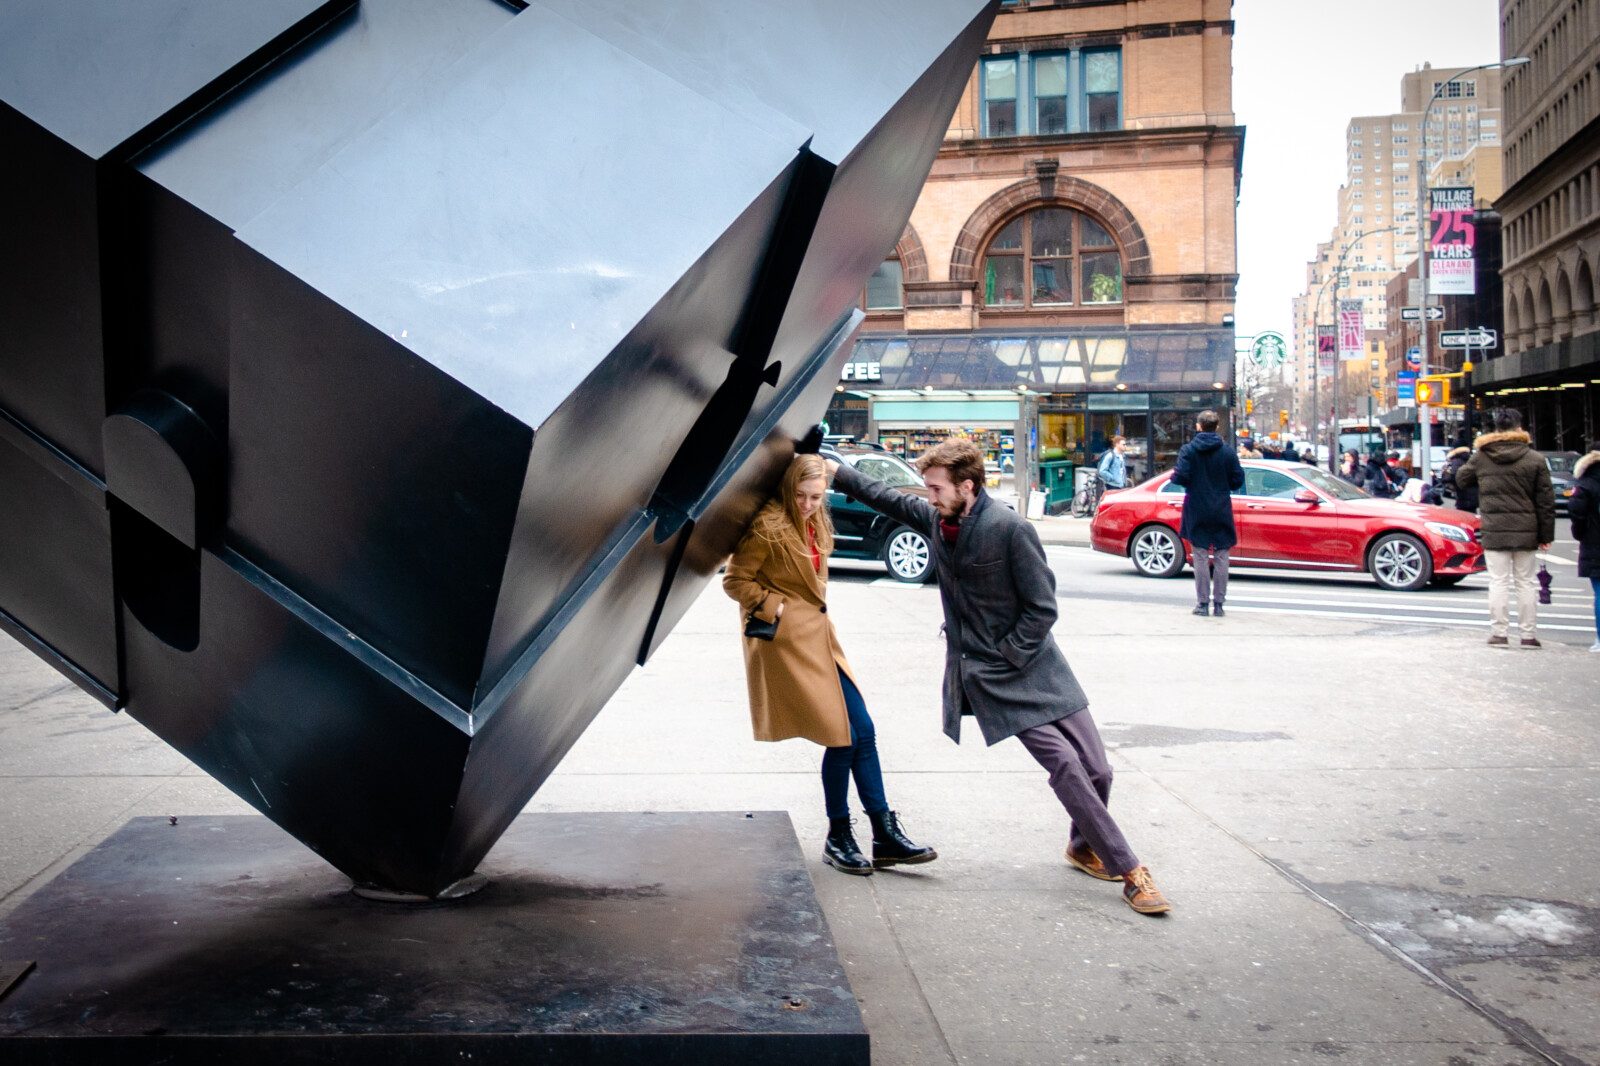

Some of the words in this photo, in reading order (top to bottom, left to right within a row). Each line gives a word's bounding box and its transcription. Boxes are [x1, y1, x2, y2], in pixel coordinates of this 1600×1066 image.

[1432, 190, 1472, 202] VILLAGE
[1432, 202, 1472, 212] ALLIANCE
[1430, 206, 1475, 252] 25
[1432, 244, 1472, 259] YEARS
[1432, 260, 1456, 269] CLEAN
[1457, 260, 1472, 268] AND
[1445, 336, 1460, 344] ONE
[1470, 335, 1488, 344] WAY
[841, 362, 881, 380] FEE
